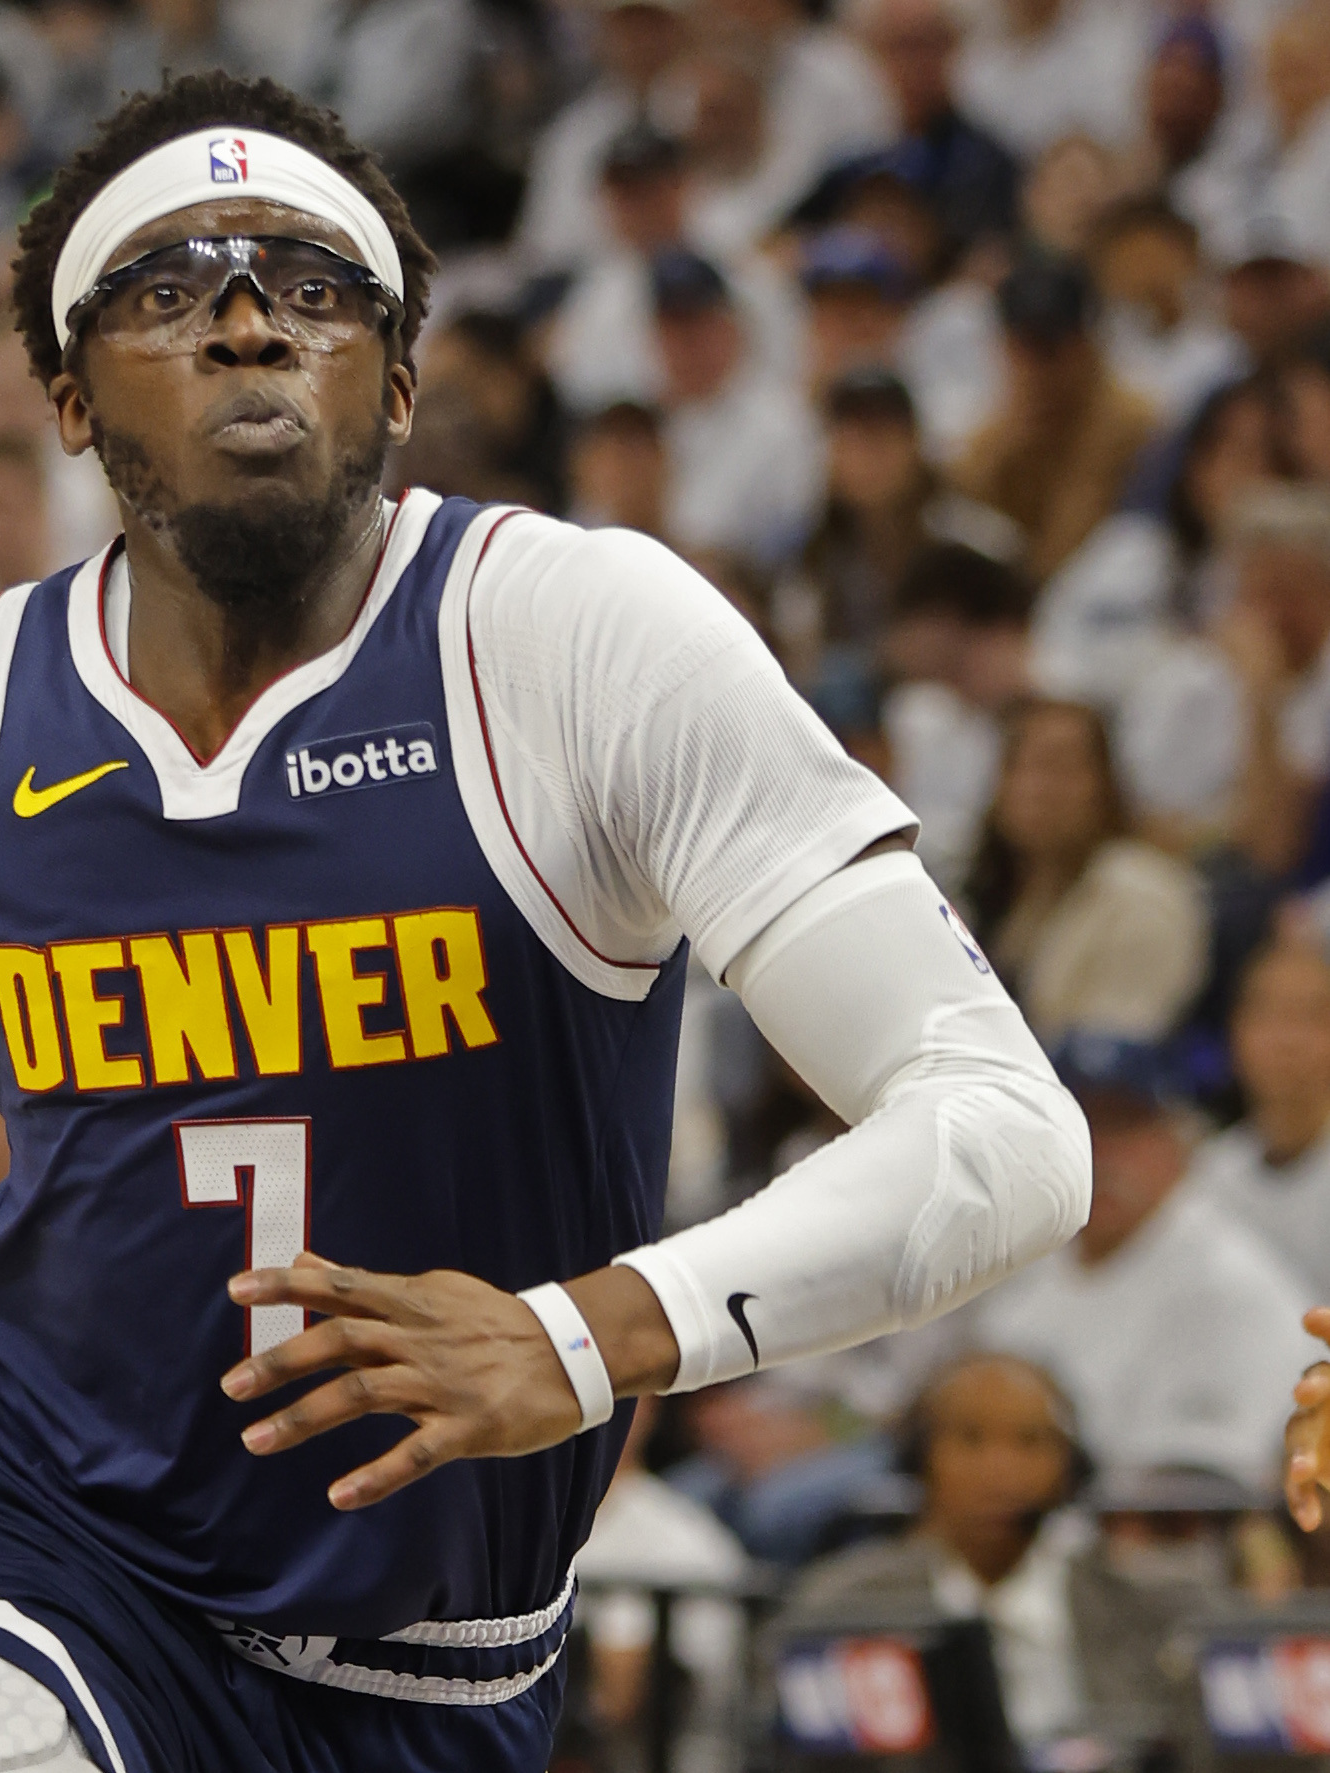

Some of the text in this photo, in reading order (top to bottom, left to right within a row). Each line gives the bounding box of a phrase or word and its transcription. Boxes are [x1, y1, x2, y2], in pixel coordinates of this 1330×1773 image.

[214, 168, 235, 181] NBA
[286, 738, 438, 797] ibotta
[171, 1116, 312, 1358] 7
